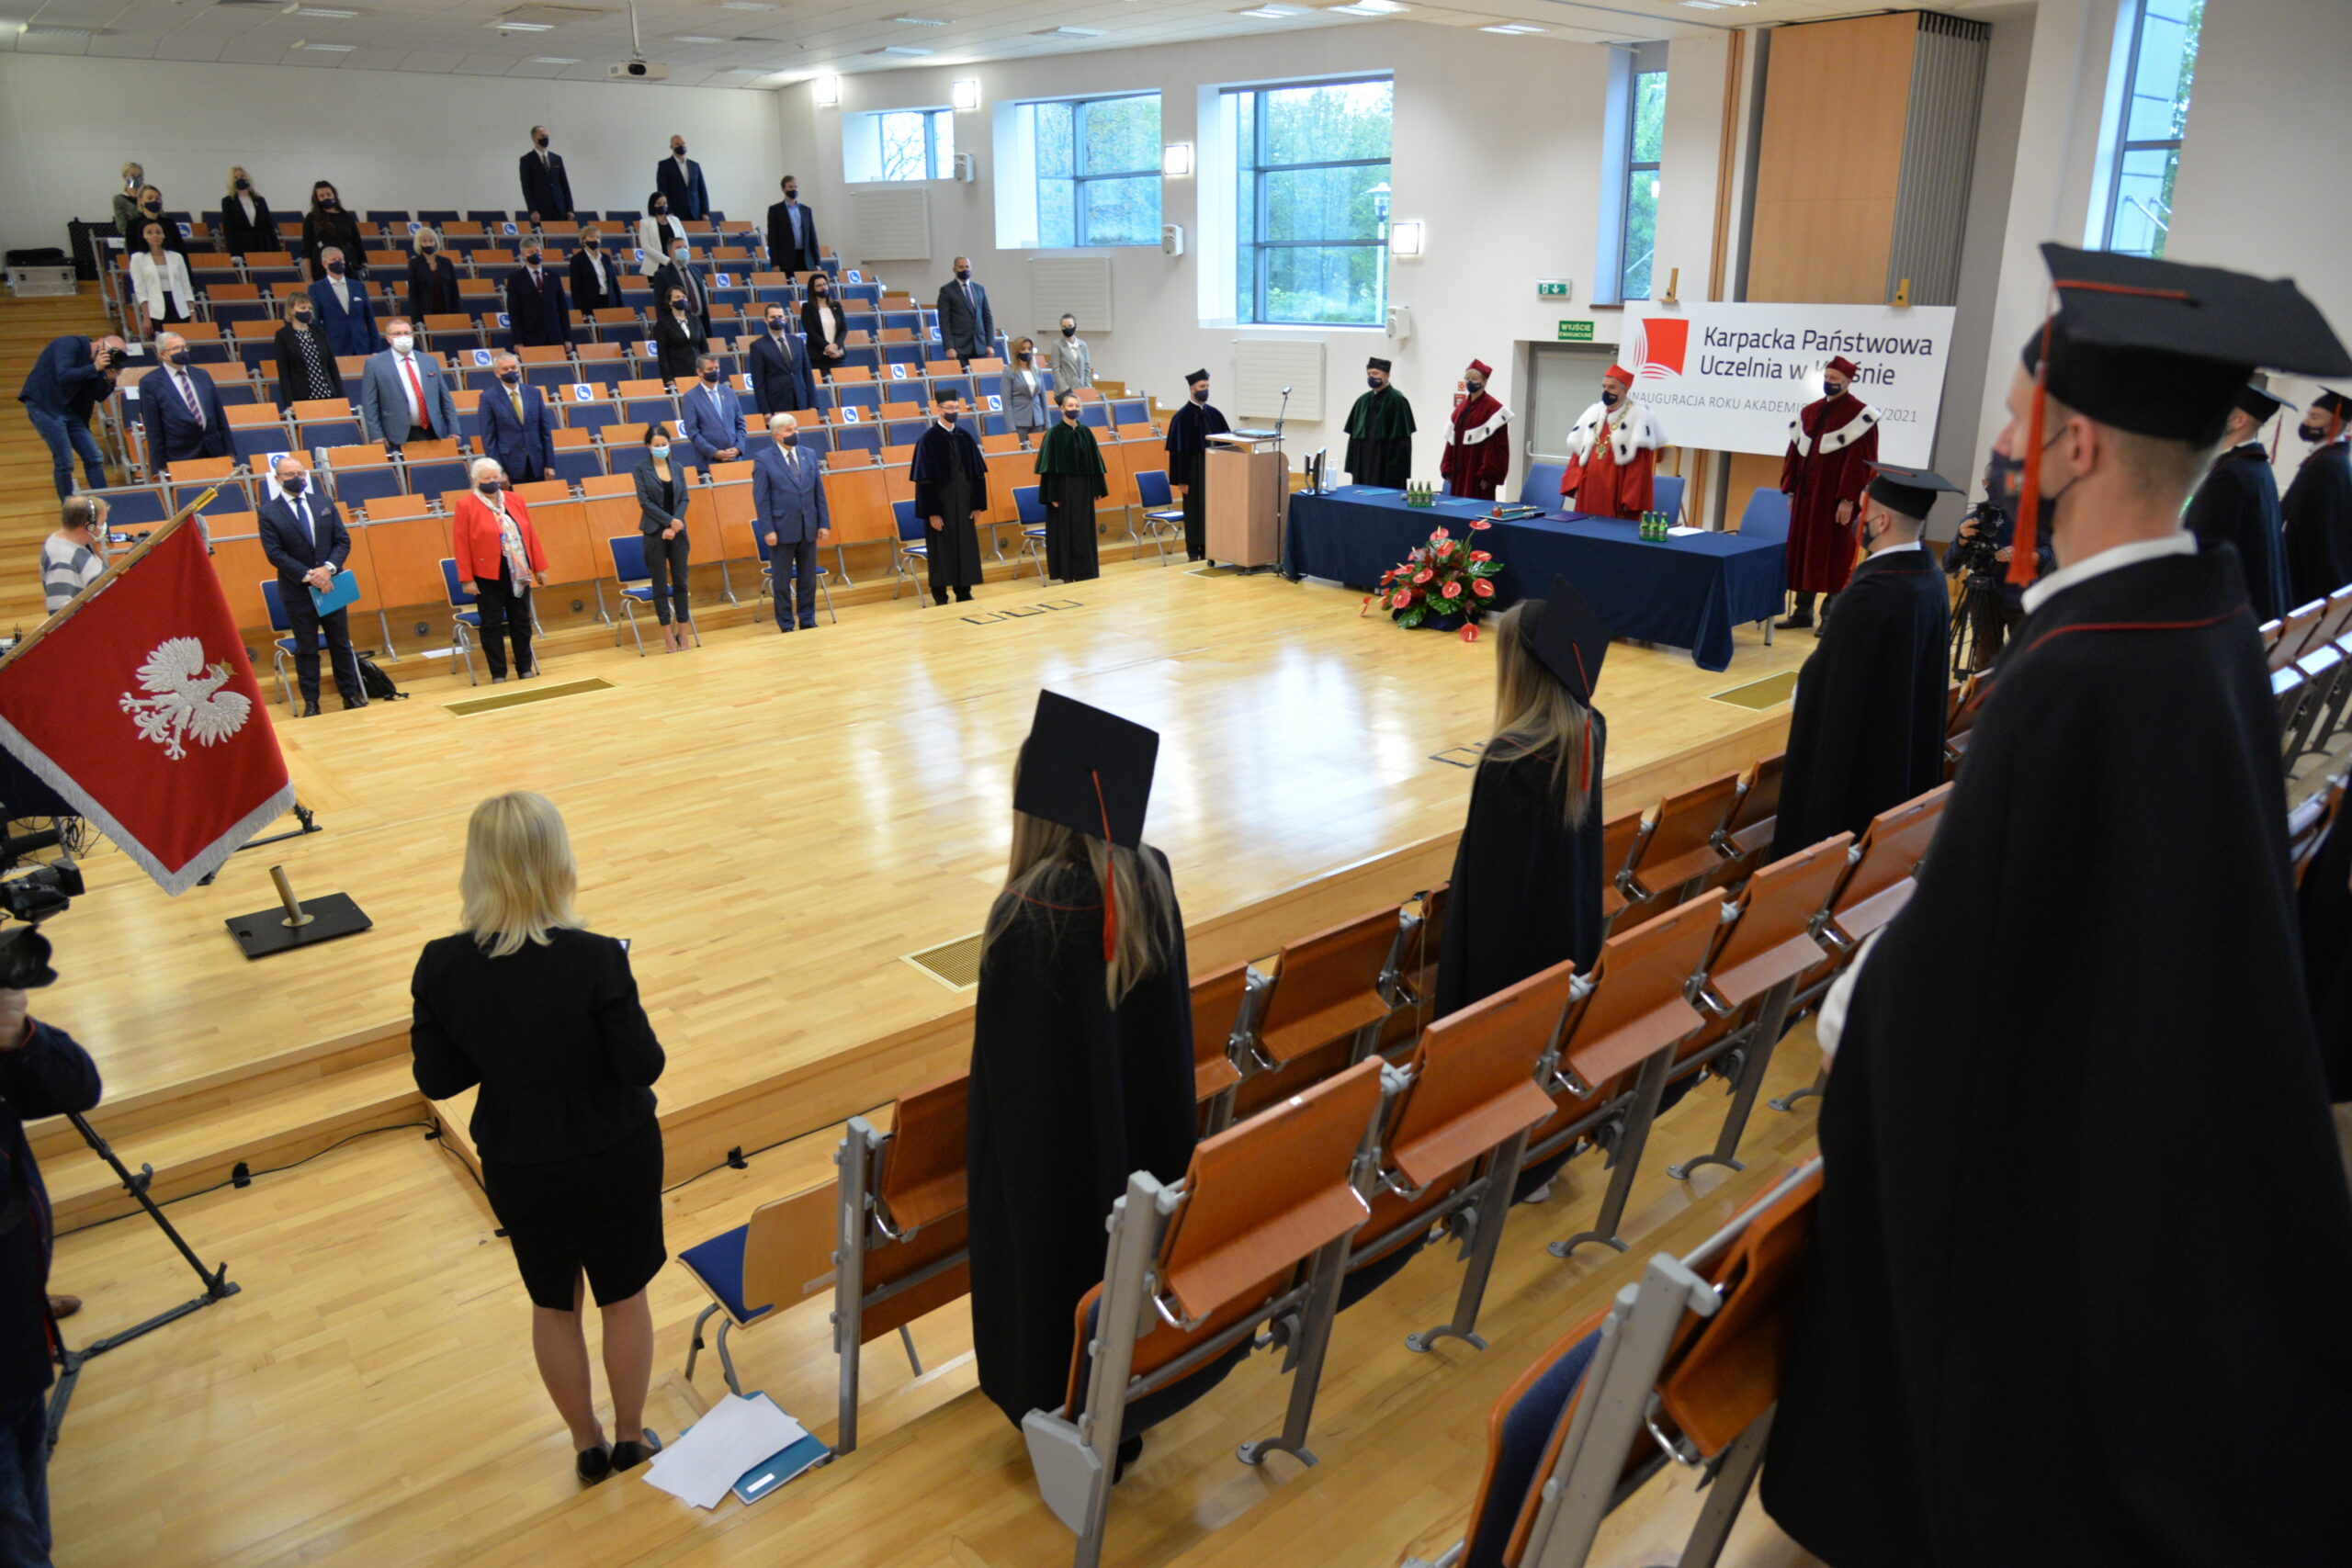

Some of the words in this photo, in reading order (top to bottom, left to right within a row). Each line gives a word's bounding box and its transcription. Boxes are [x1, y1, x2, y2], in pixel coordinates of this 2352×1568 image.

[1704, 326, 1795, 354] Karpacka
[1802, 329, 1933, 355] Państwowa
[1701, 355, 1782, 378] Uczelnia
[1790, 364, 1808, 379] w
[1629, 391, 1705, 407] INAUGURACJA
[1709, 396, 1741, 410] ROKU
